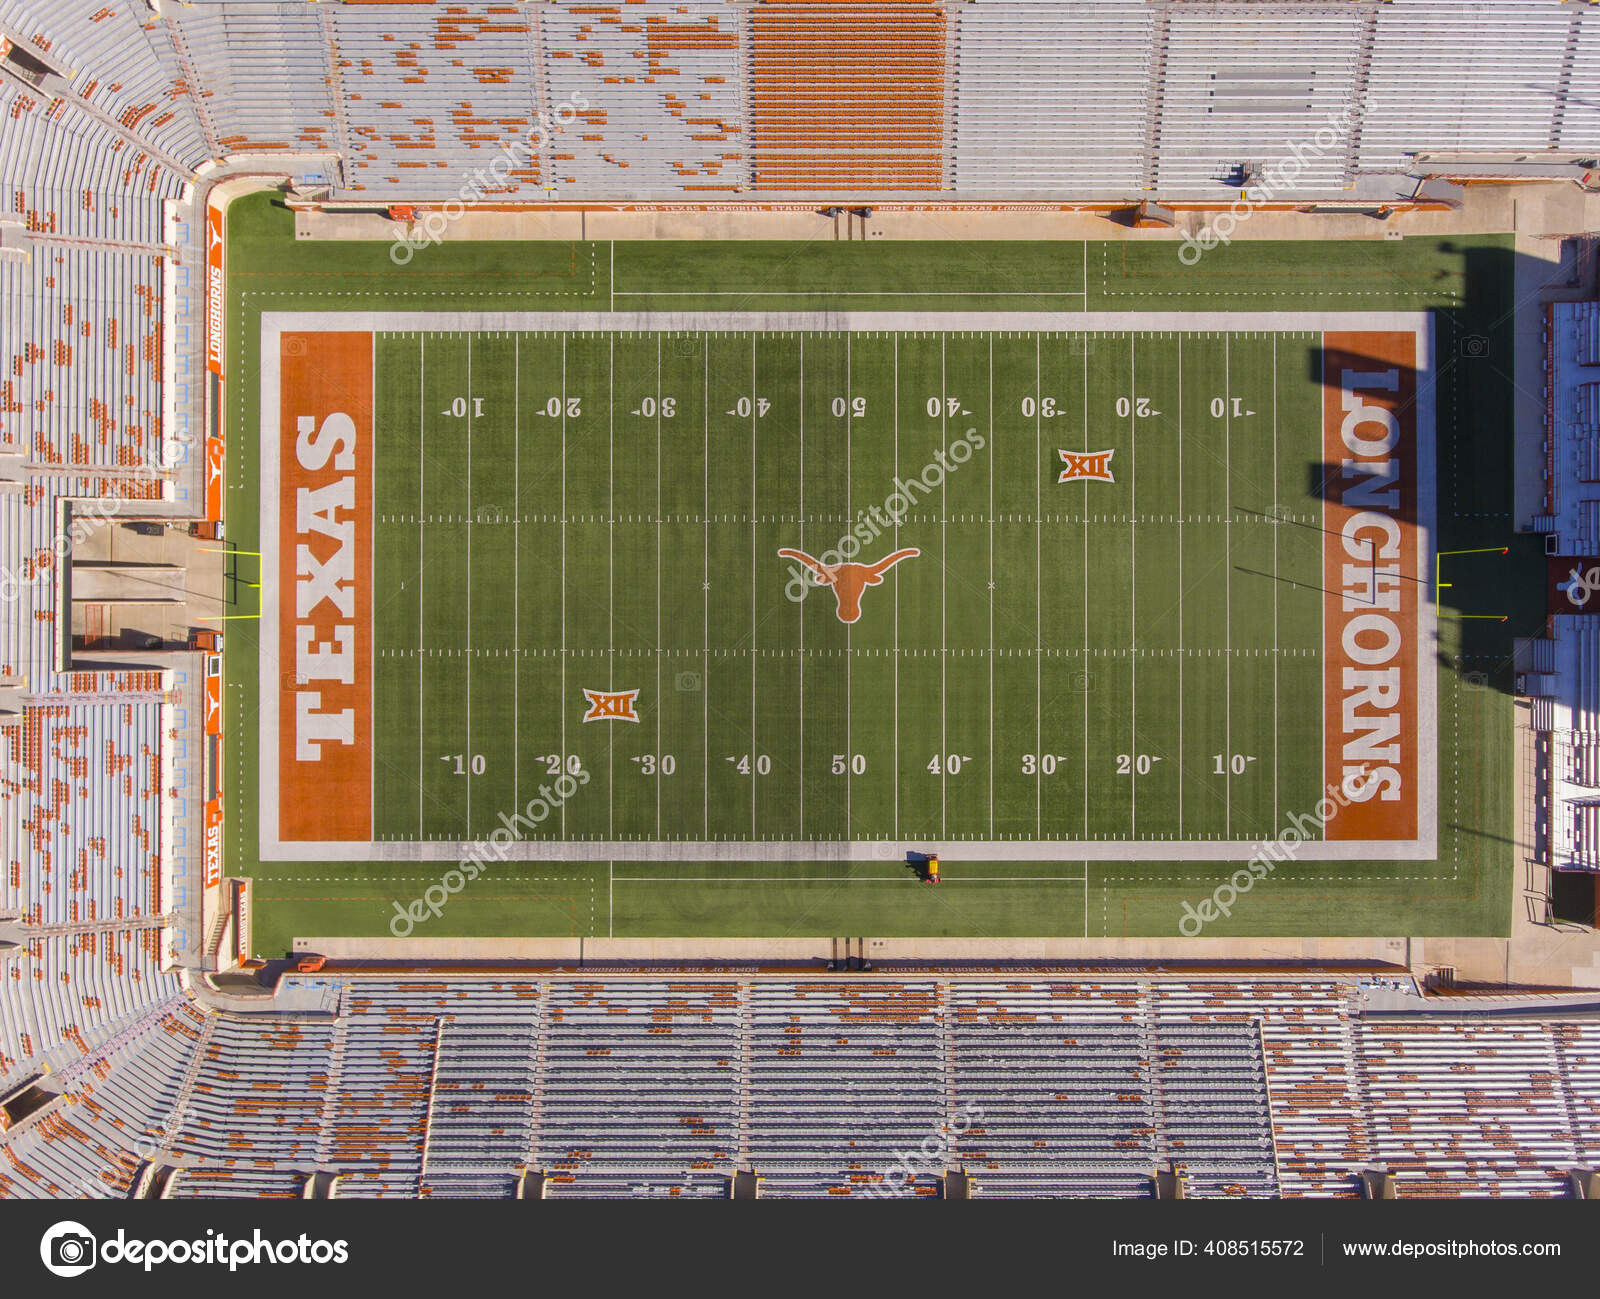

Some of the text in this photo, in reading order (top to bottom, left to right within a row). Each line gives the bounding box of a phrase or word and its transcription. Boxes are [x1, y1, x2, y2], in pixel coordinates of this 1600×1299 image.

[209, 265, 222, 365] LONGHORNS
[452, 397, 485, 418] 10
[547, 397, 581, 418] 20
[641, 397, 676, 418] 30
[736, 397, 771, 418] 40
[831, 397, 866, 418] 50
[926, 397, 961, 418] 40
[1021, 397, 1057, 418] 30
[1116, 397, 1150, 418] 20
[1211, 397, 1244, 418] 10
[296, 411, 357, 762] TEXAS
[1341, 368, 1402, 803] LONGHORNS
[453, 754, 486, 775] 10
[546, 754, 581, 775] 20
[641, 754, 676, 775] 30
[736, 754, 771, 775] 40
[831, 754, 866, 775] 50
[926, 754, 961, 775] 40
[1021, 754, 1057, 775] 30
[1116, 754, 1151, 775] 20
[1213, 754, 1246, 775] 10
[207, 825, 219, 888] TEXAS
